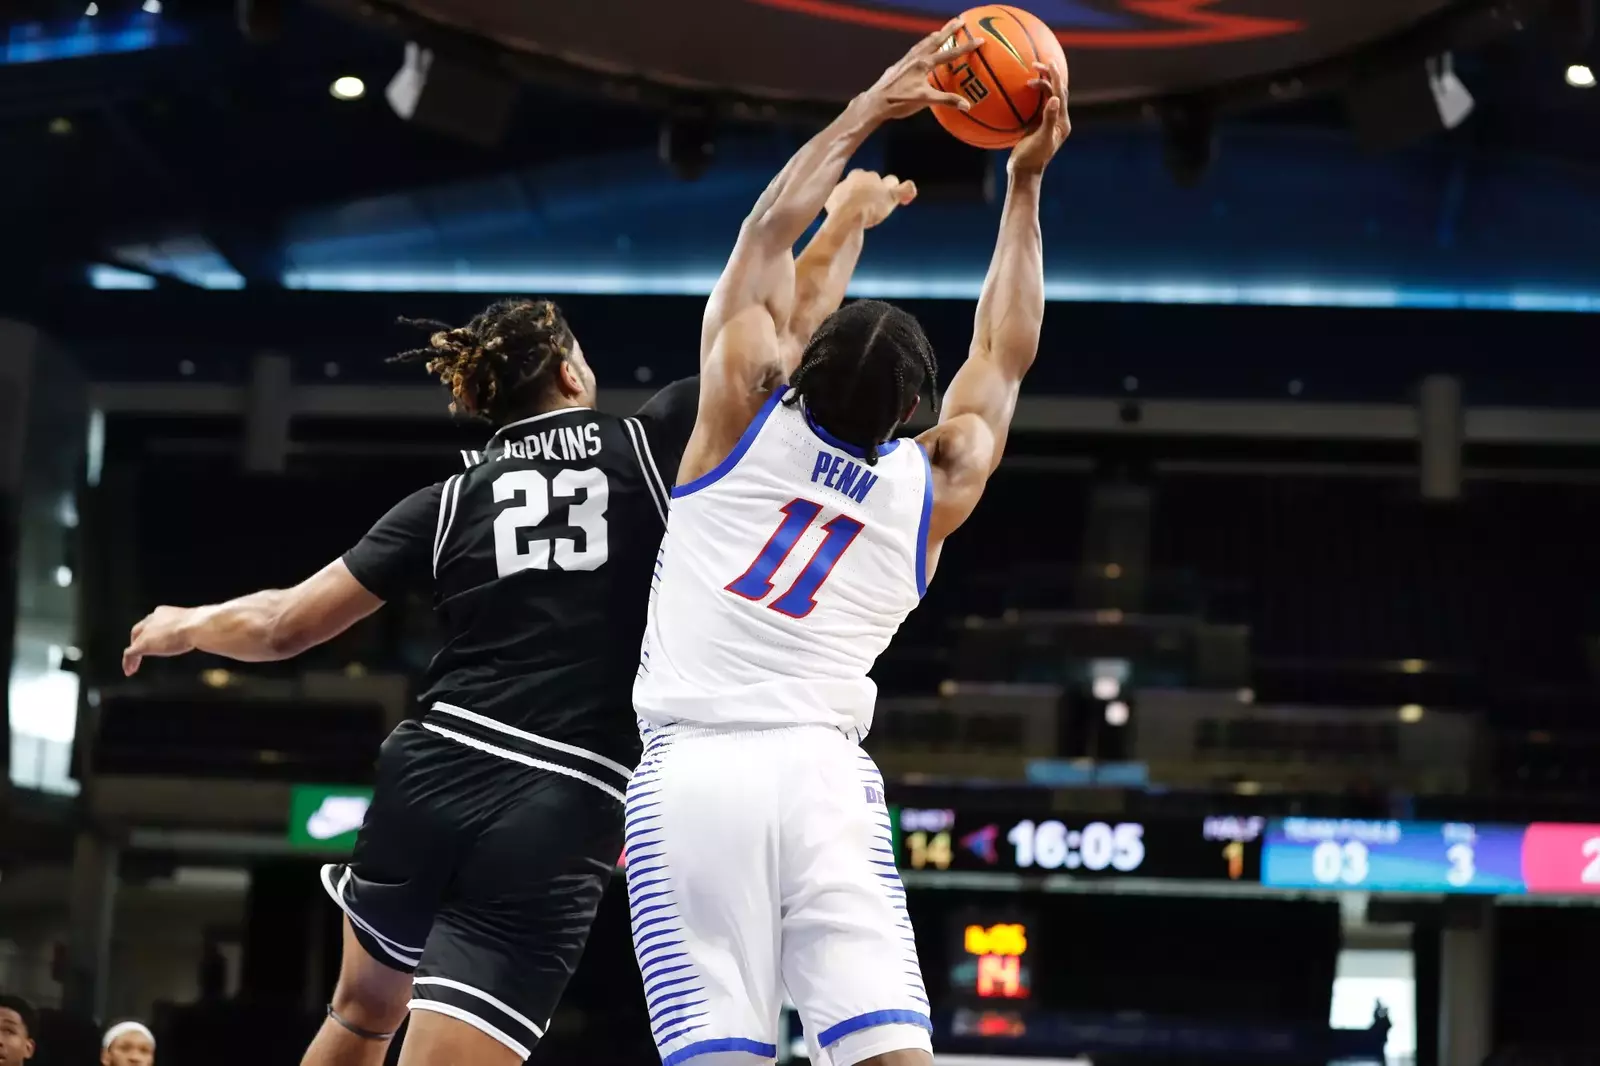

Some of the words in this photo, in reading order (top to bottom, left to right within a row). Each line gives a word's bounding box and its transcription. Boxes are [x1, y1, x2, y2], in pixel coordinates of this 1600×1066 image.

[811, 451, 878, 504] PENN
[492, 467, 609, 578] 23
[723, 497, 866, 618] 11
[906, 831, 953, 869] 14
[1008, 820, 1145, 871] 16:05
[1313, 841, 1369, 884] 03
[1446, 844, 1475, 887] 3
